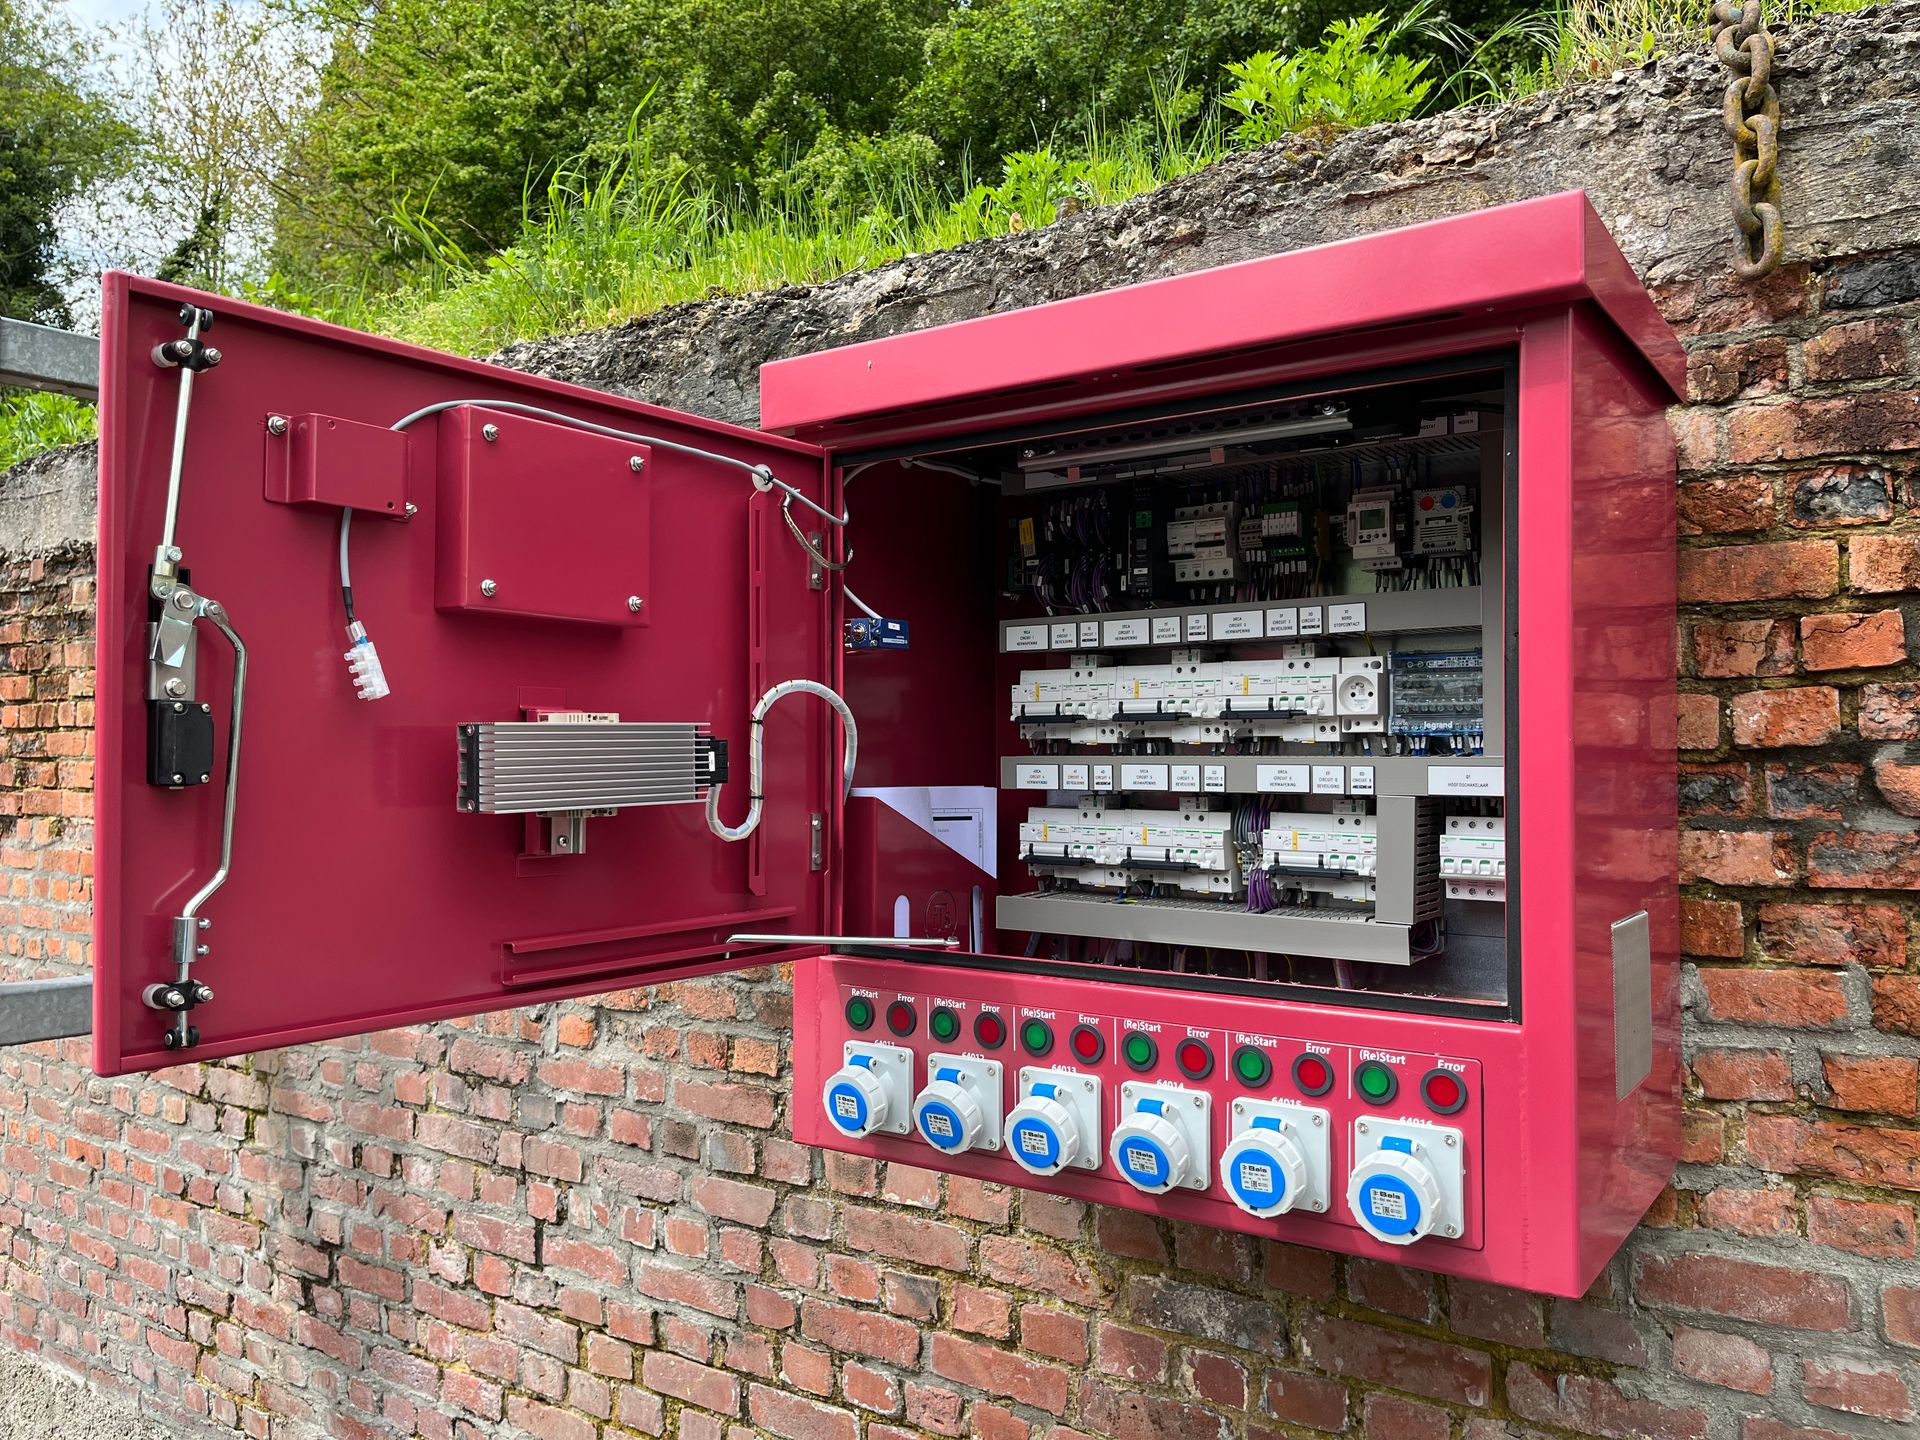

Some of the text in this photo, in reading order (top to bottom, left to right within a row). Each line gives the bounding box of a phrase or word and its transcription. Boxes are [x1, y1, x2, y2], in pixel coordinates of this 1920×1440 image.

[1424, 721, 1452, 730] legrand
[898, 994, 914, 1003] Error
[934, 998, 1000, 1013] (Re)Start Error
[1021, 1008, 1099, 1024] (Re)Start Error
[1124, 1019, 1210, 1038] (Re)Start Error
[1236, 1033, 1330, 1055] (Re)Start Error
[1360, 1049, 1466, 1072] (Re)Start Error
[1052, 1064, 1076, 1074] 64013
